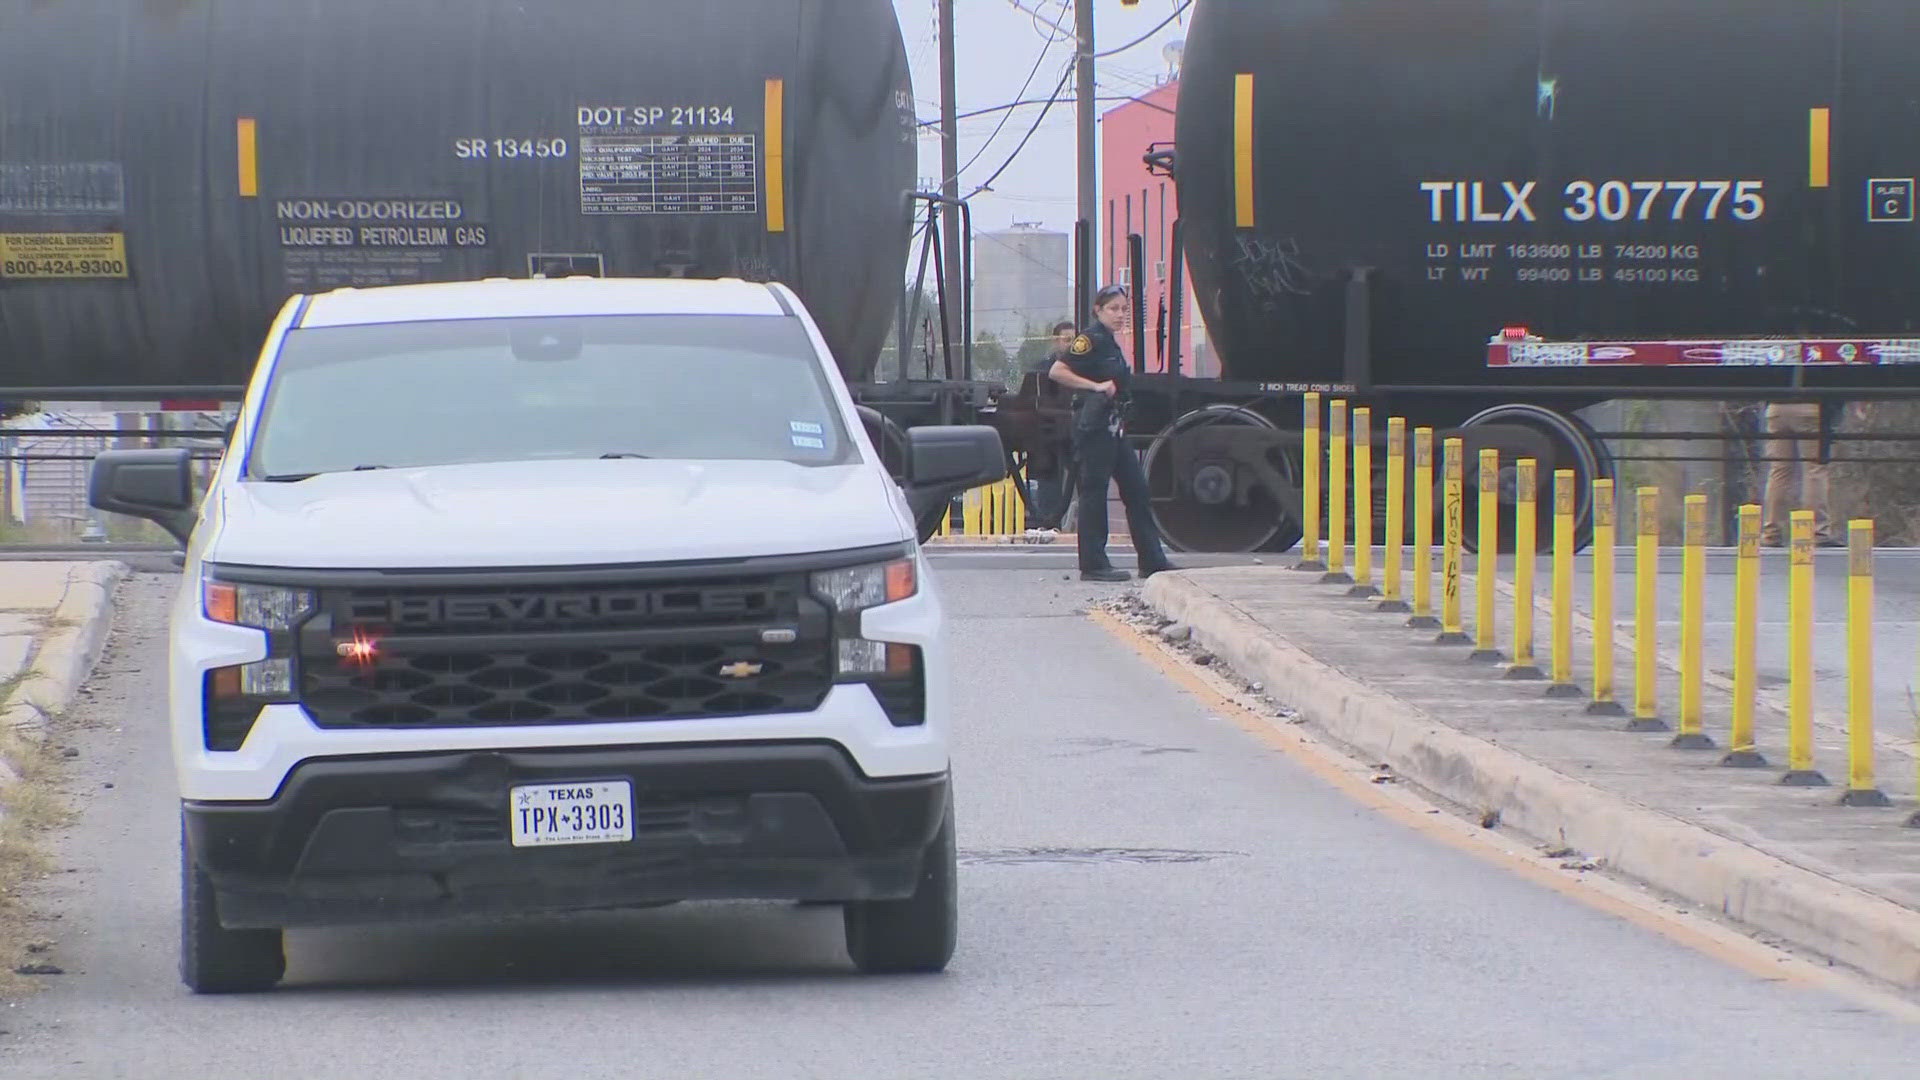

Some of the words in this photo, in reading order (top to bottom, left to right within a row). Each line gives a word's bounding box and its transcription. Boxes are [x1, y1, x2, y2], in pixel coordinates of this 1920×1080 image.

[578, 106, 664, 126] DOT-SP
[671, 106, 735, 126] 21134
[455, 138, 487, 159] SR
[494, 138, 567, 159] 13450
[1876, 186, 1905, 195] PLATE
[1420, 180, 1536, 223] TILX
[1563, 179, 1765, 222] 307775
[1885, 199, 1899, 214] C
[277, 200, 462, 219] NON-ODORIZED
[5, 236, 22, 246] FOR
[24, 236, 65, 246] CHEMICAL
[66, 236, 114, 246] EMERGENCY
[280, 226, 354, 246] LIQUEFIED
[361, 226, 448, 246] PETROLEUM
[455, 226, 487, 246] GAS
[1427, 244, 1448, 259] LD
[1460, 244, 1497, 259] LMT
[1506, 244, 1571, 259] 163600
[1578, 244, 1602, 259] LB
[1615, 245, 1666, 259] 74200
[1671, 245, 1699, 259] KG
[5, 260, 123, 275] 800-424-9300
[1427, 267, 1446, 281] LT
[1461, 267, 1490, 281] WT
[1517, 267, 1571, 281] 99400
[1578, 267, 1602, 281] LB
[1614, 267, 1666, 281] 45100
[1671, 267, 1699, 281] KG
[1259, 383, 1265, 391] 2
[1286, 383, 1309, 392] TREAD
[548, 788, 593, 801] TEXAS
